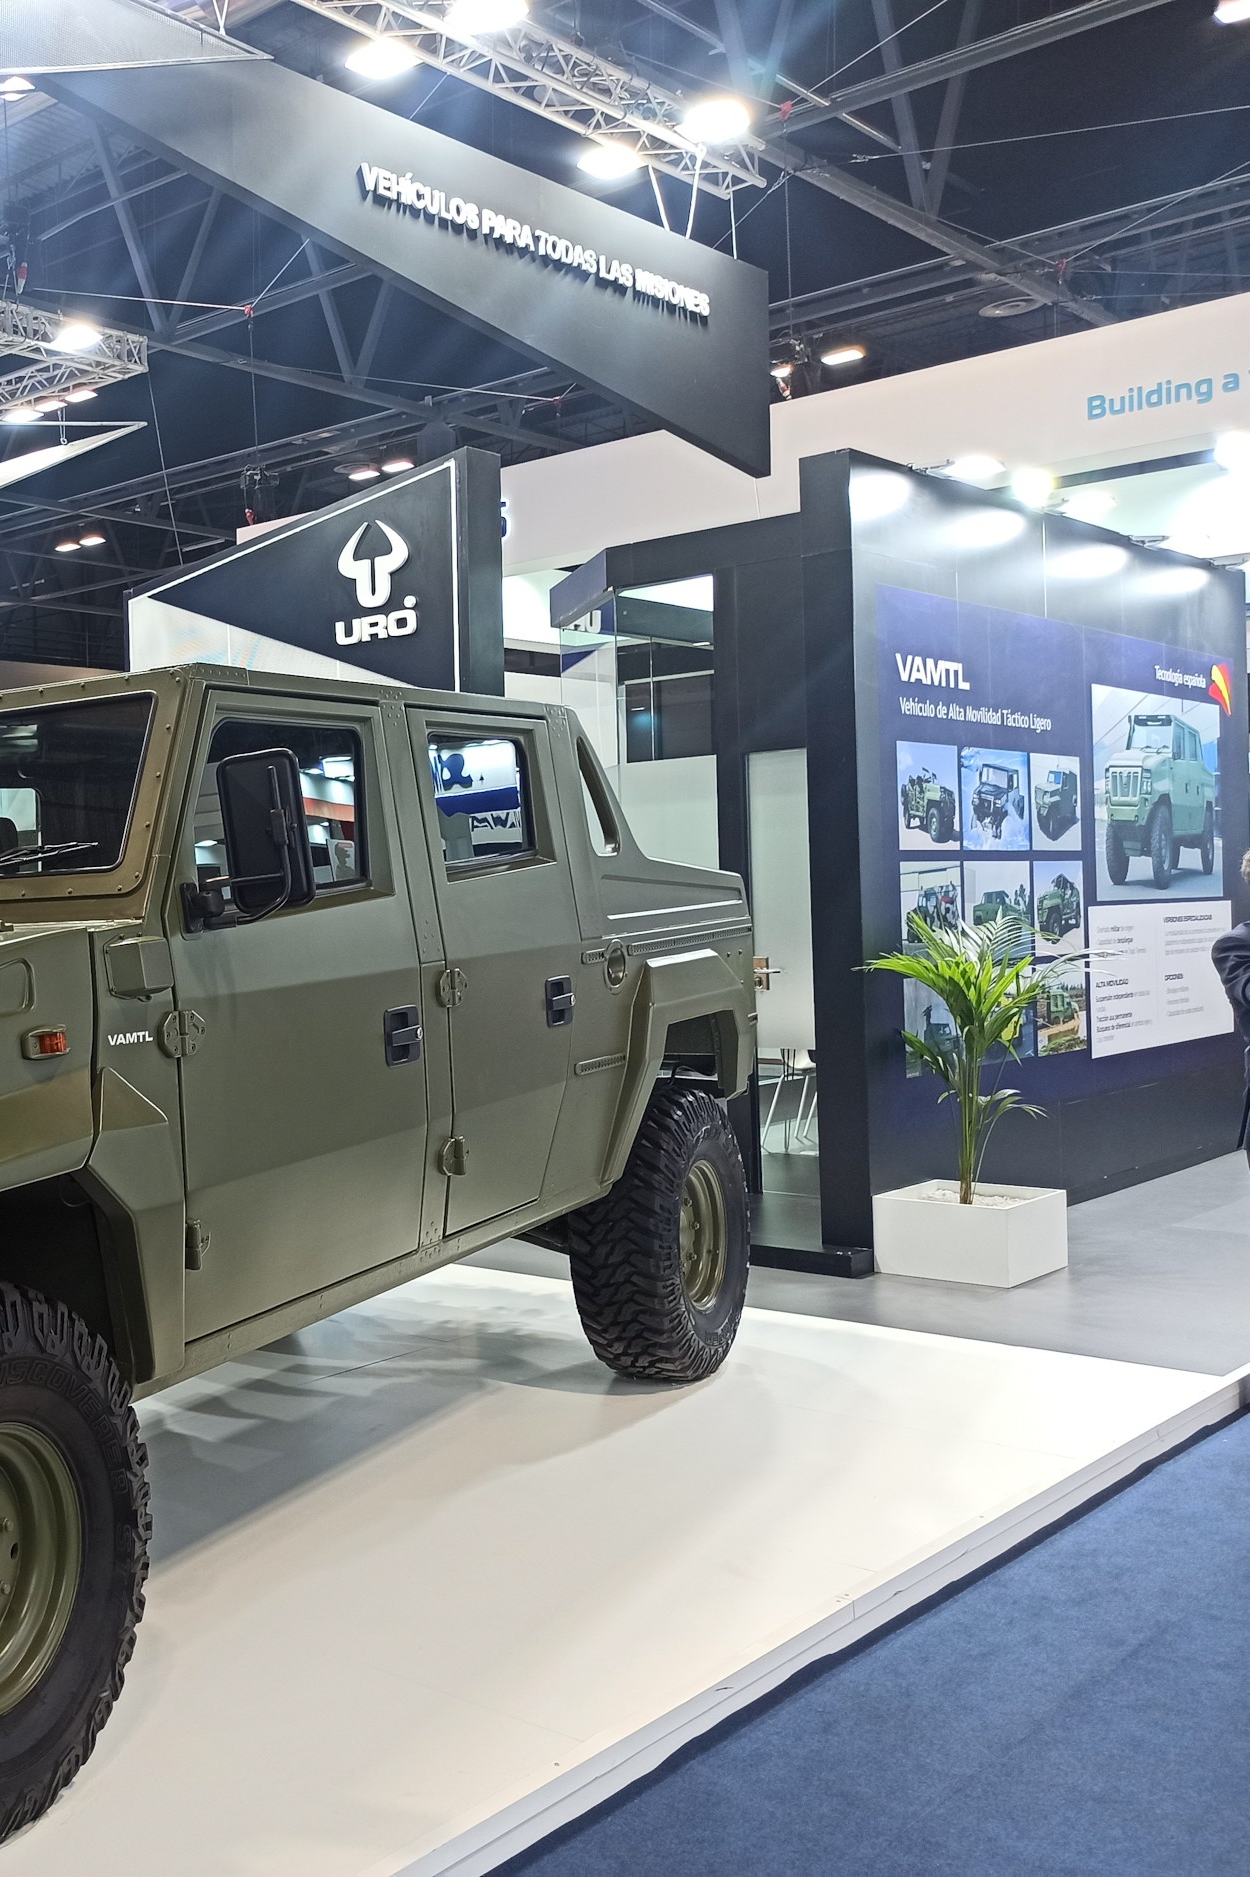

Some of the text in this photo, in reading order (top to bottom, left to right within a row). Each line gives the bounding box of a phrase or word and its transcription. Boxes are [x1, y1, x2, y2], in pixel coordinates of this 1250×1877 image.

[360, 162, 711, 317] VEHÍCULOS PARA TODAS LAS MISIONES
[1087, 372, 1240, 421] Building a
[895, 653, 970, 690] VAMTL
[899, 697, 1052, 733] Vehículo de Alta Movilidad Táctico Ligero
[107, 1030, 154, 1046] VAMTL
